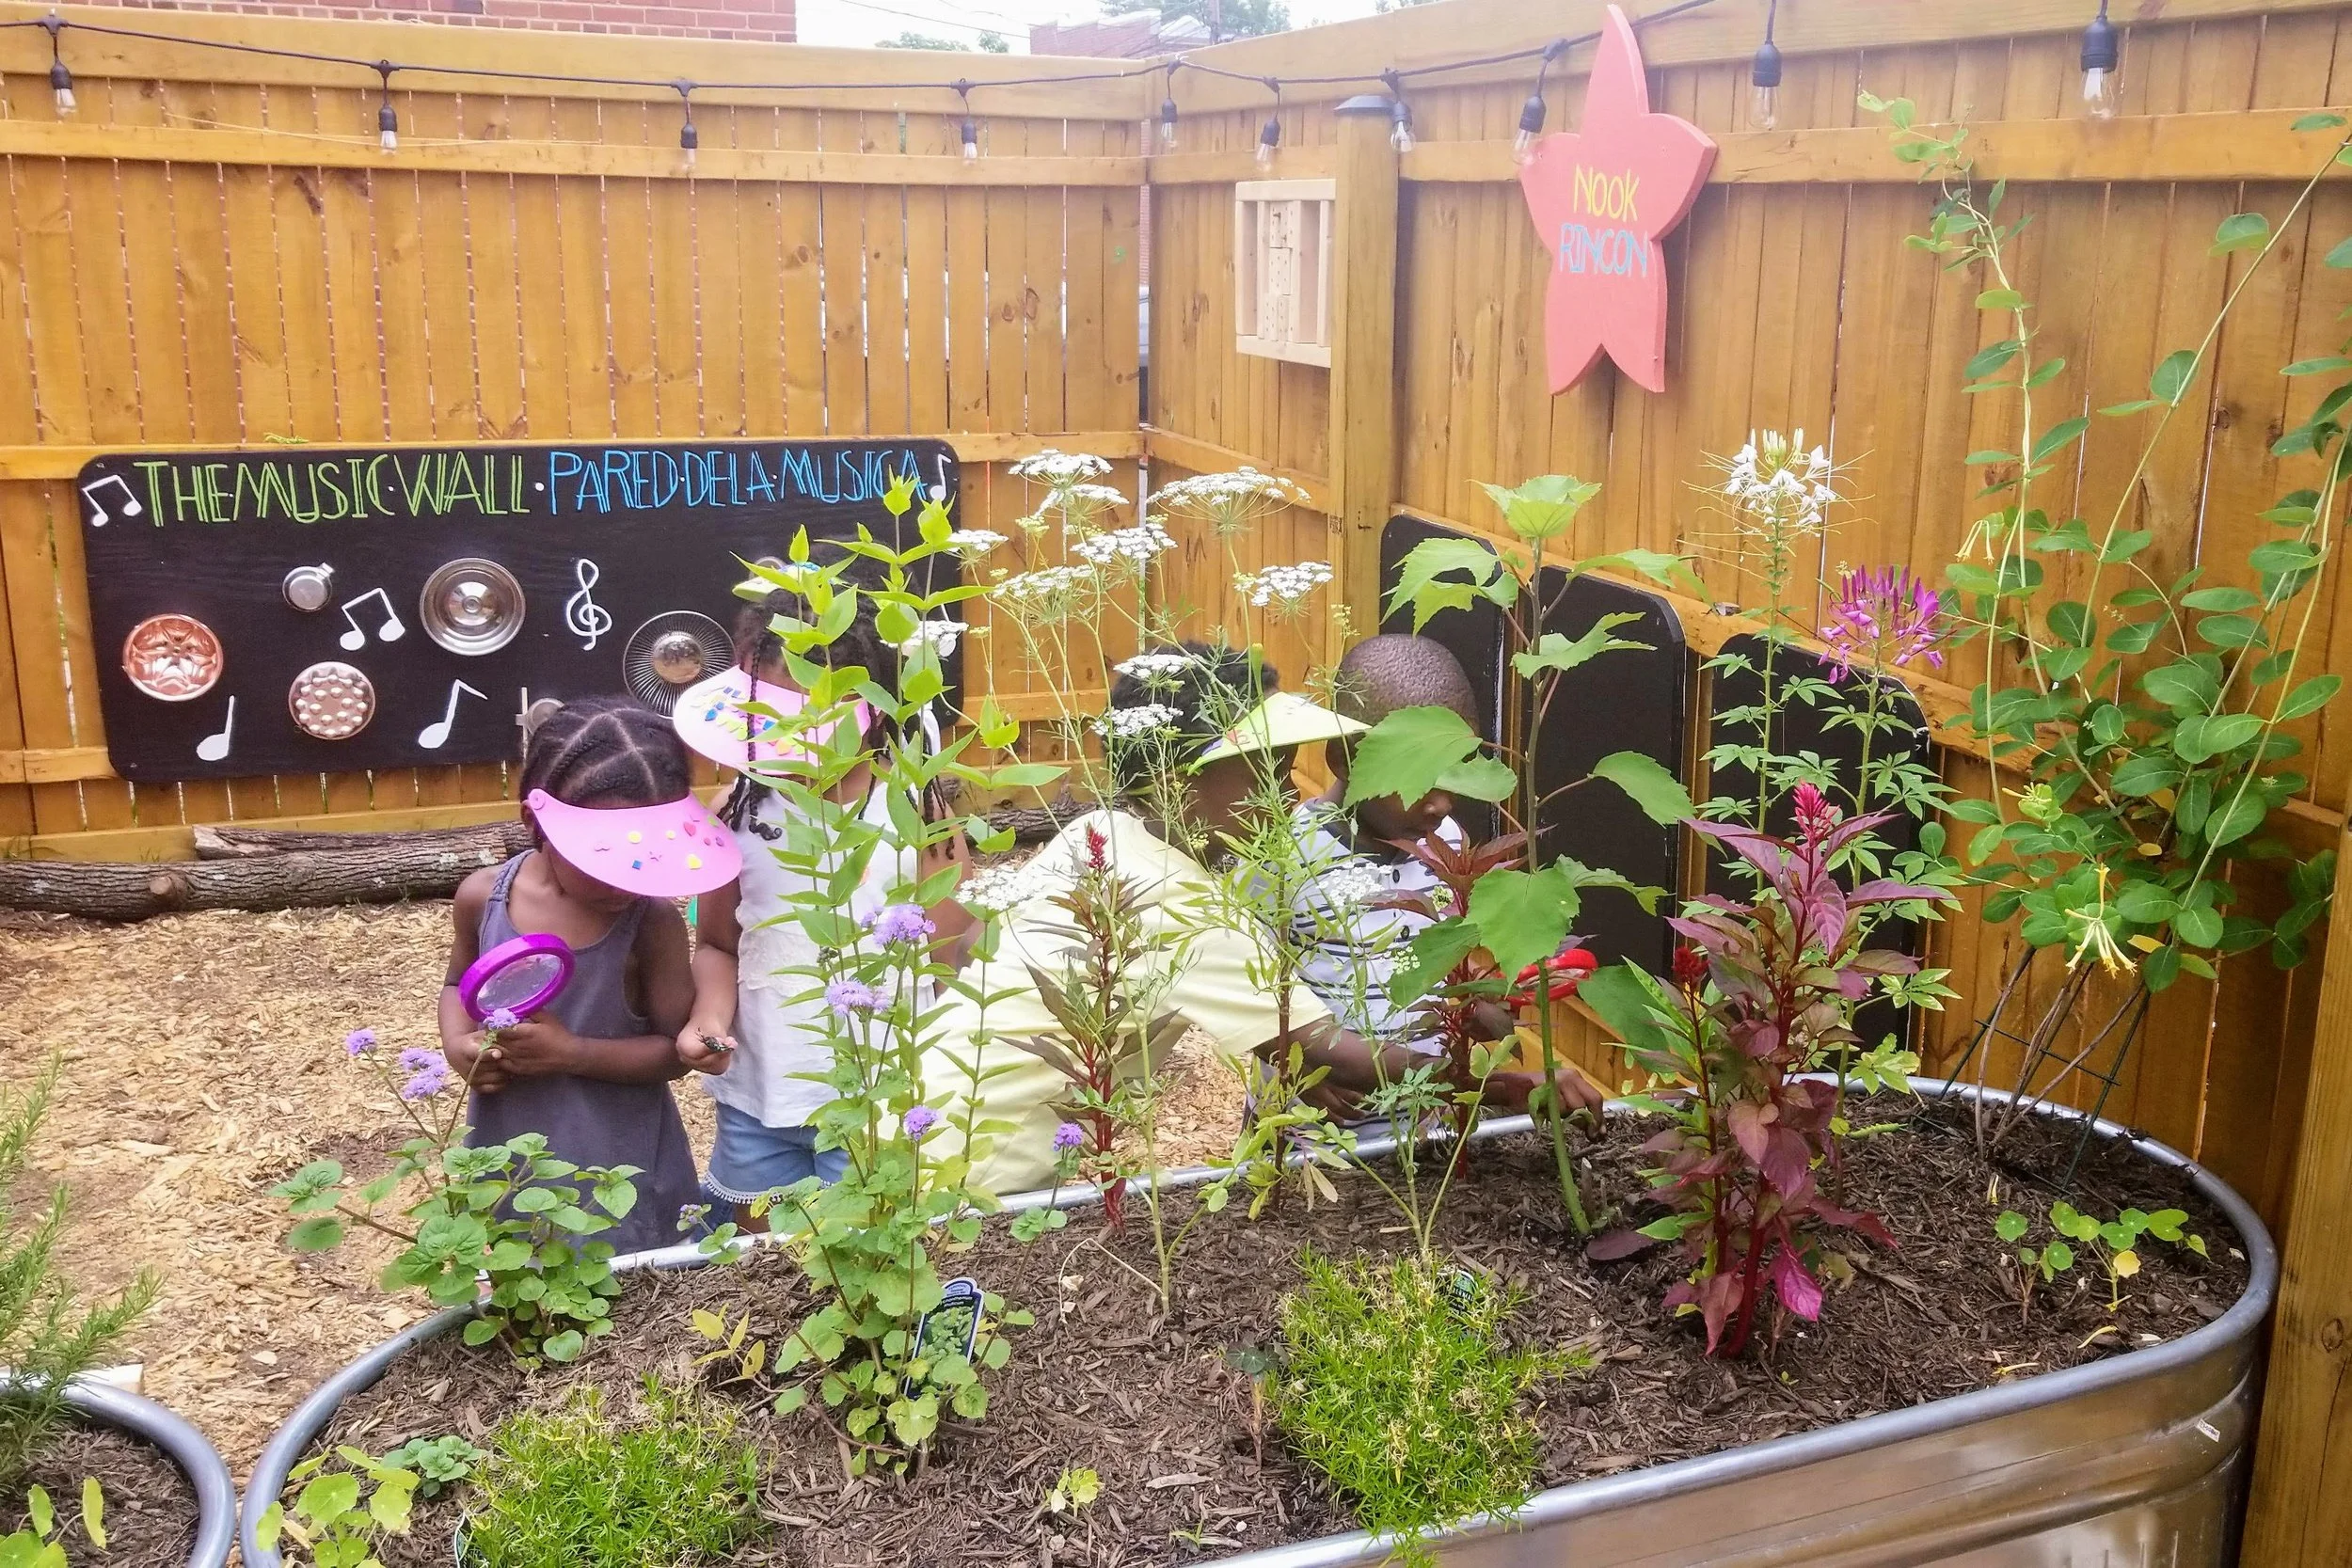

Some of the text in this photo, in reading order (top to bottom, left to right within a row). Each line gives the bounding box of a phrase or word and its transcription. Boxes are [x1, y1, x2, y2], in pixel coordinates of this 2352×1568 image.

[1573, 164, 1640, 223] NOOK
[1560, 222, 1648, 278] RINCON
[133, 448, 928, 528] THE MUSIC WALL PARED DE LA MUSICA
